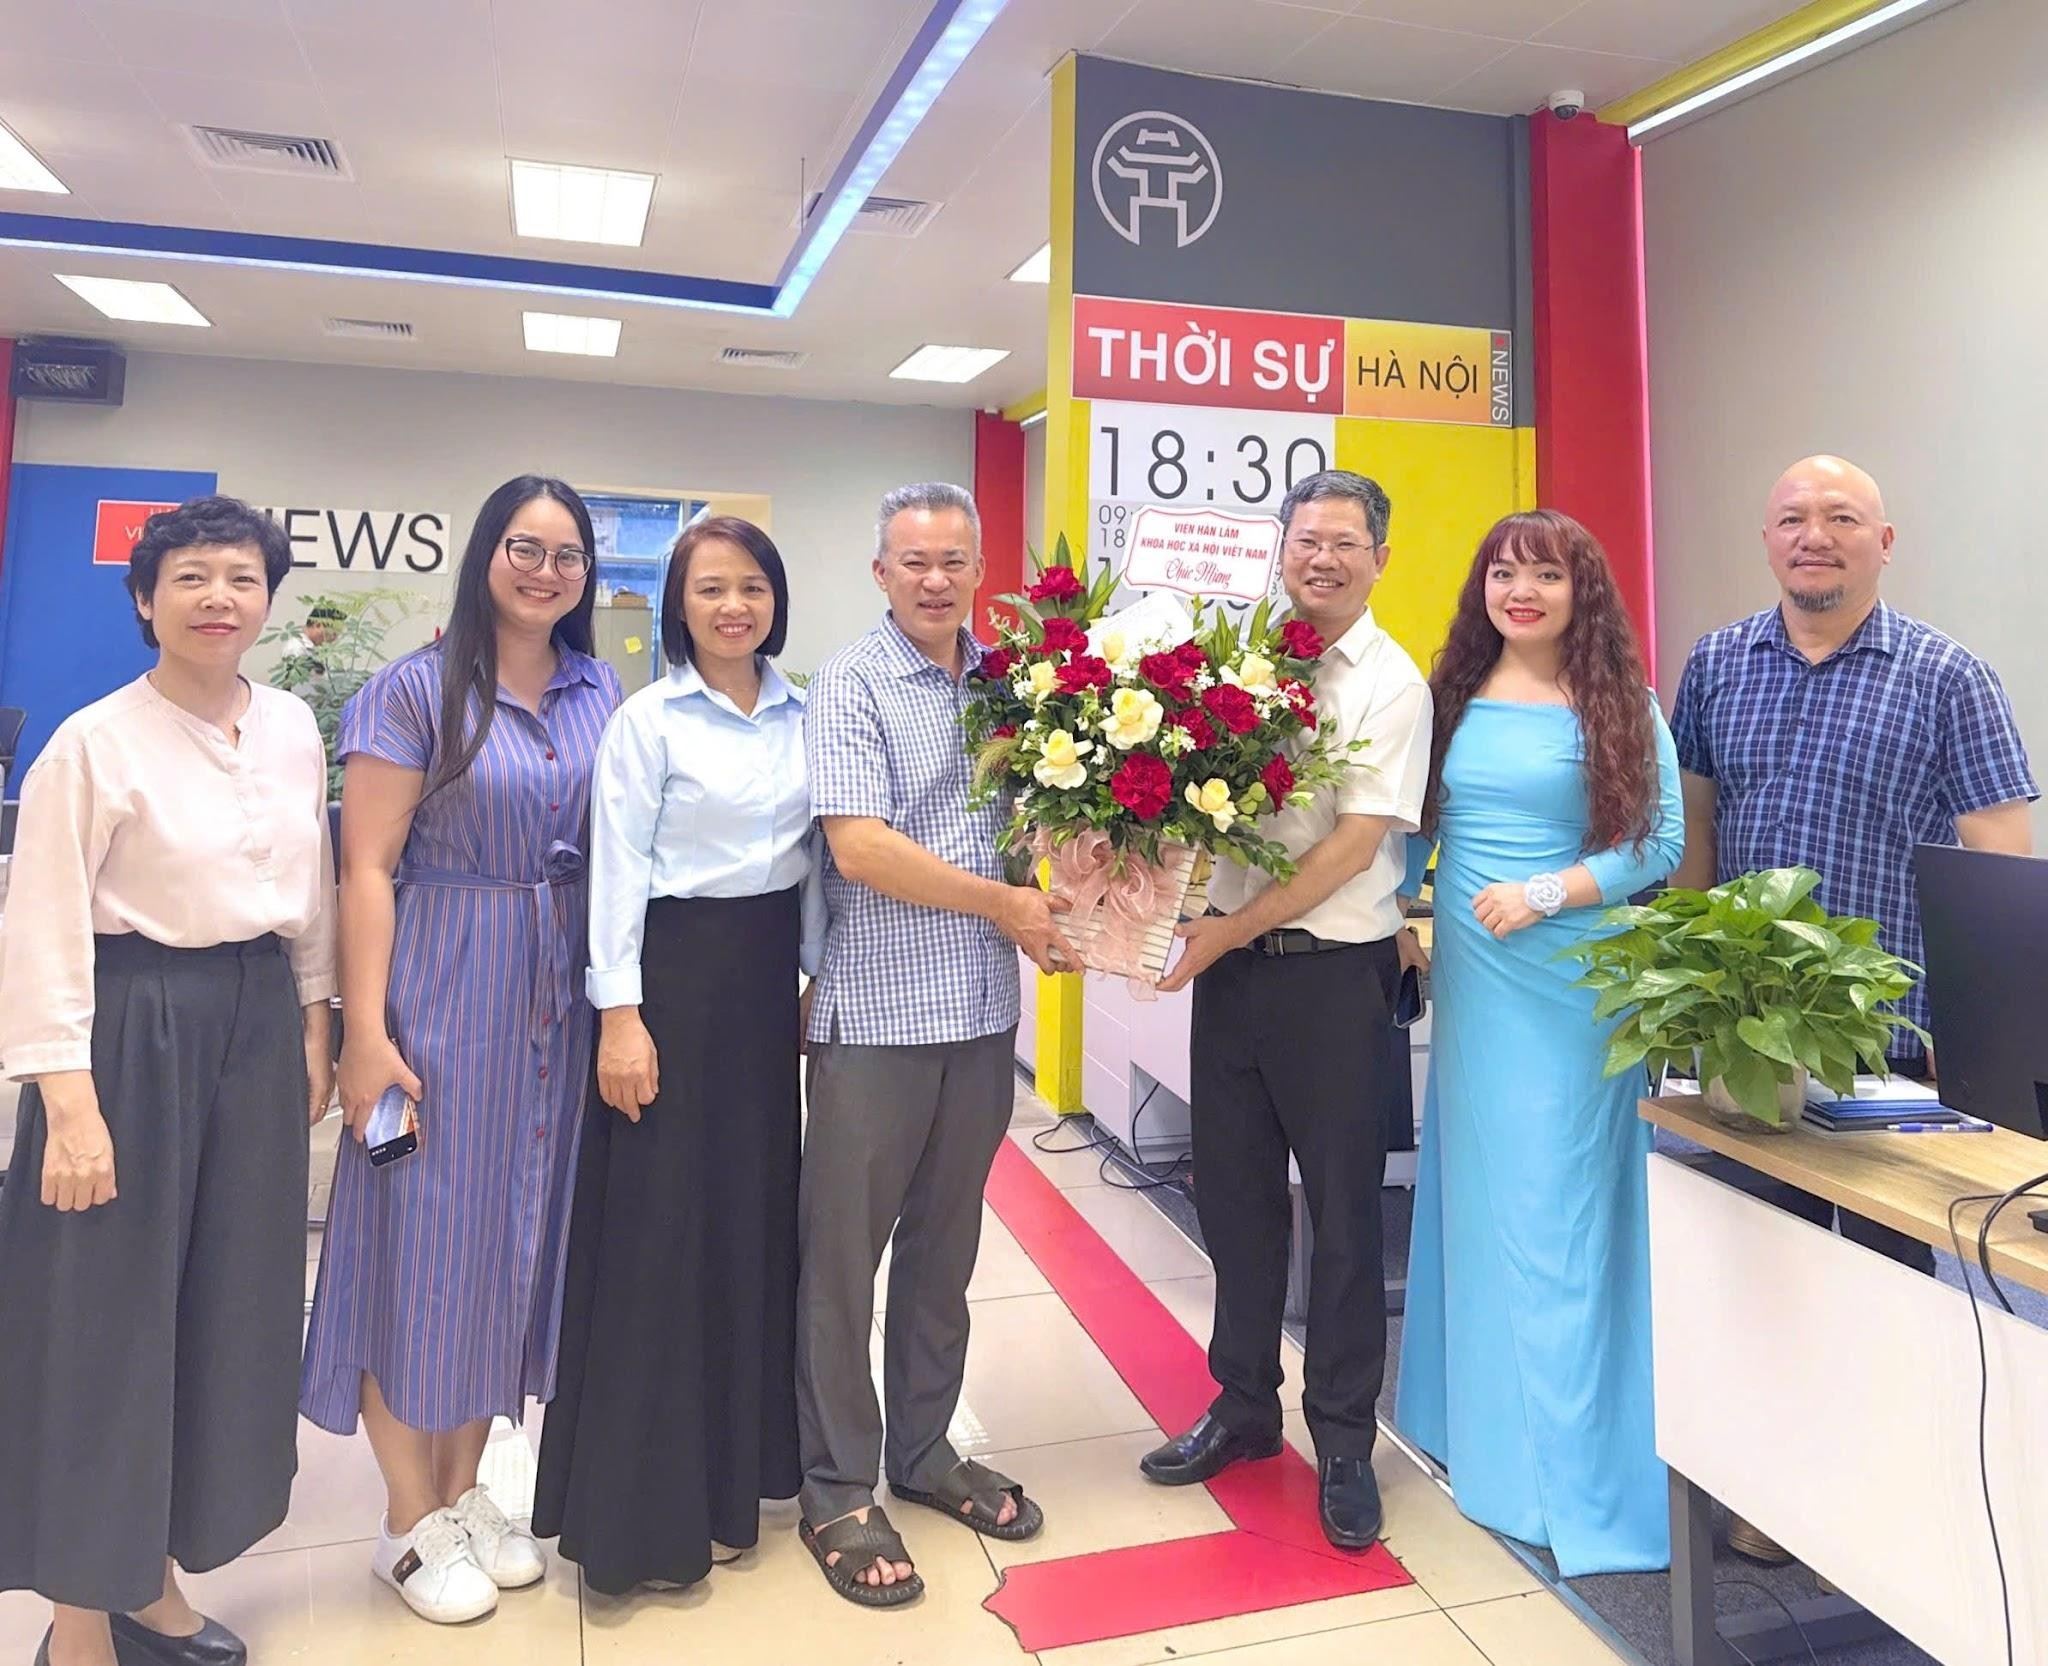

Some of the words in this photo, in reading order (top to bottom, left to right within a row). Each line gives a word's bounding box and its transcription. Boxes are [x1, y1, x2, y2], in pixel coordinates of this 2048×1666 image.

[1088, 321, 1231, 387] THỜI
[1253, 339, 1335, 403] SỰ
[1358, 350, 1406, 389] HÀ
[1420, 355, 1477, 399] NỘI
[1492, 350, 1509, 422] NEWS
[1101, 426, 1327, 503] 18:30
[125, 524, 145, 541] VI
[1099, 505, 1132, 525] 09
[265, 508, 444, 572] EWS
[1140, 537, 1164, 550] KHOA
[1245, 548, 1268, 560] NAM
[1165, 557, 1194, 582] Chúc
